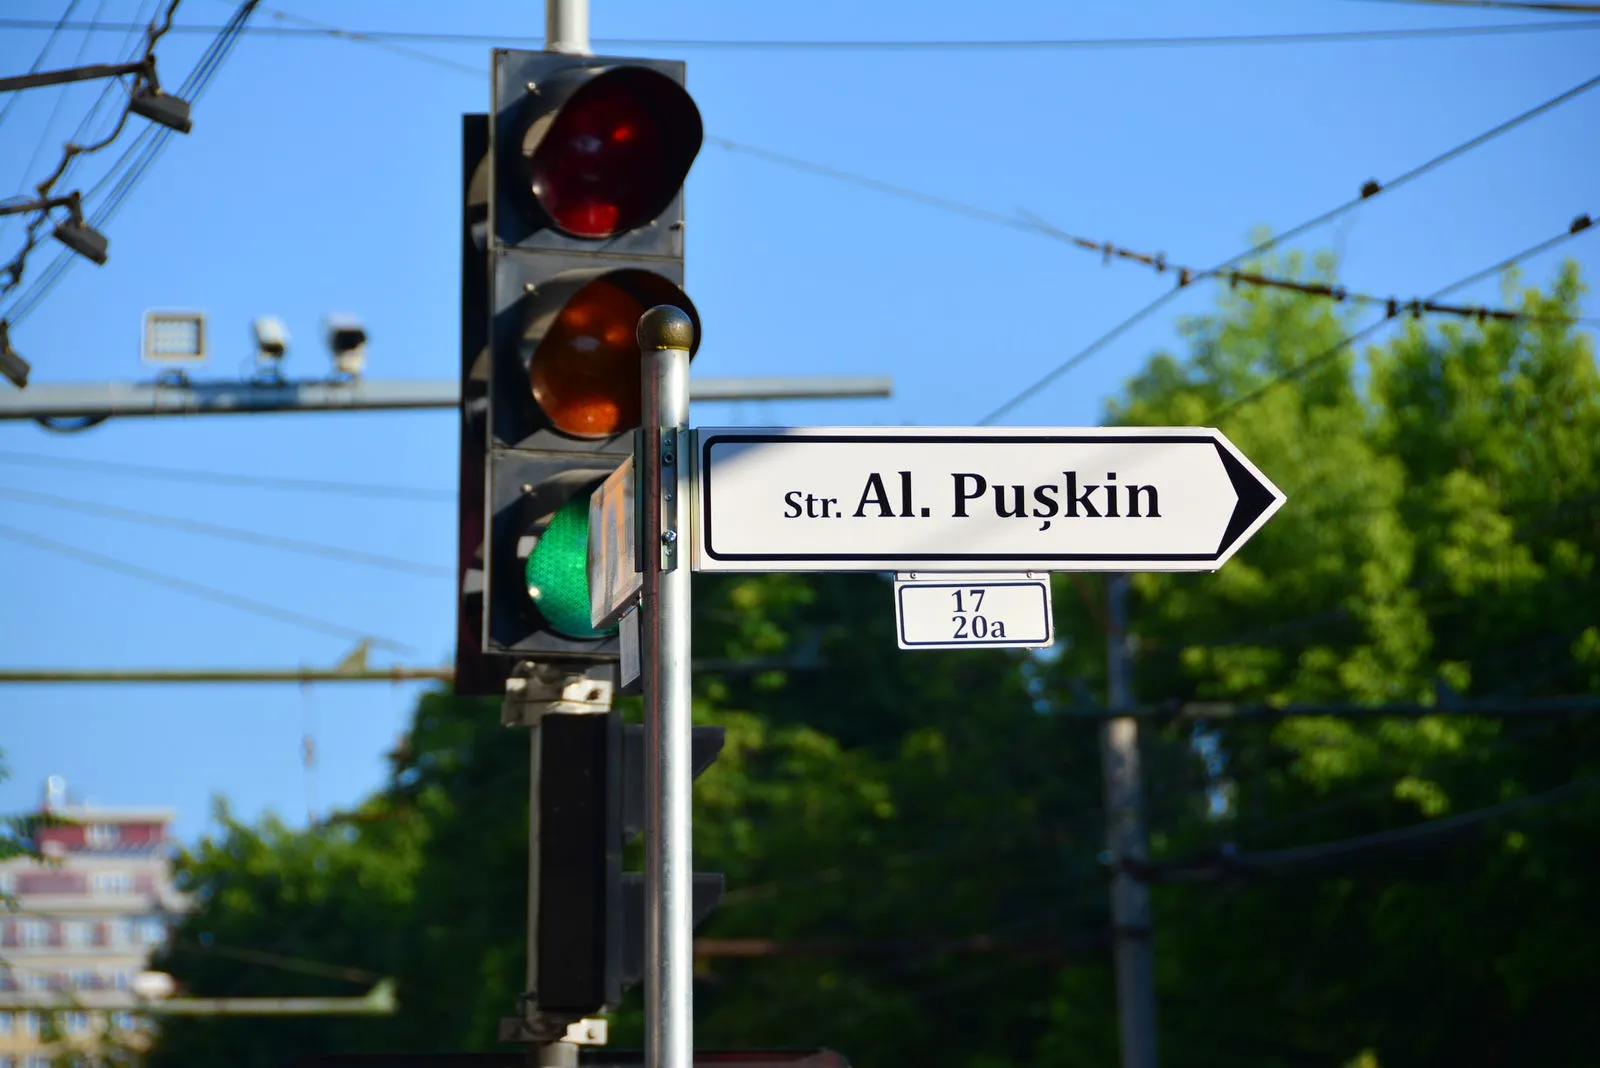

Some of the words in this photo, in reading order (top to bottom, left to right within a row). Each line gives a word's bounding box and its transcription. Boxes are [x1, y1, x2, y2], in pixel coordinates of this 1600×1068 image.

[784, 491, 842, 519] Str.
[852, 470, 930, 518] Al.
[950, 470, 1162, 532] Pușkin
[951, 589, 986, 613] 17
[952, 615, 1007, 639] 20a
